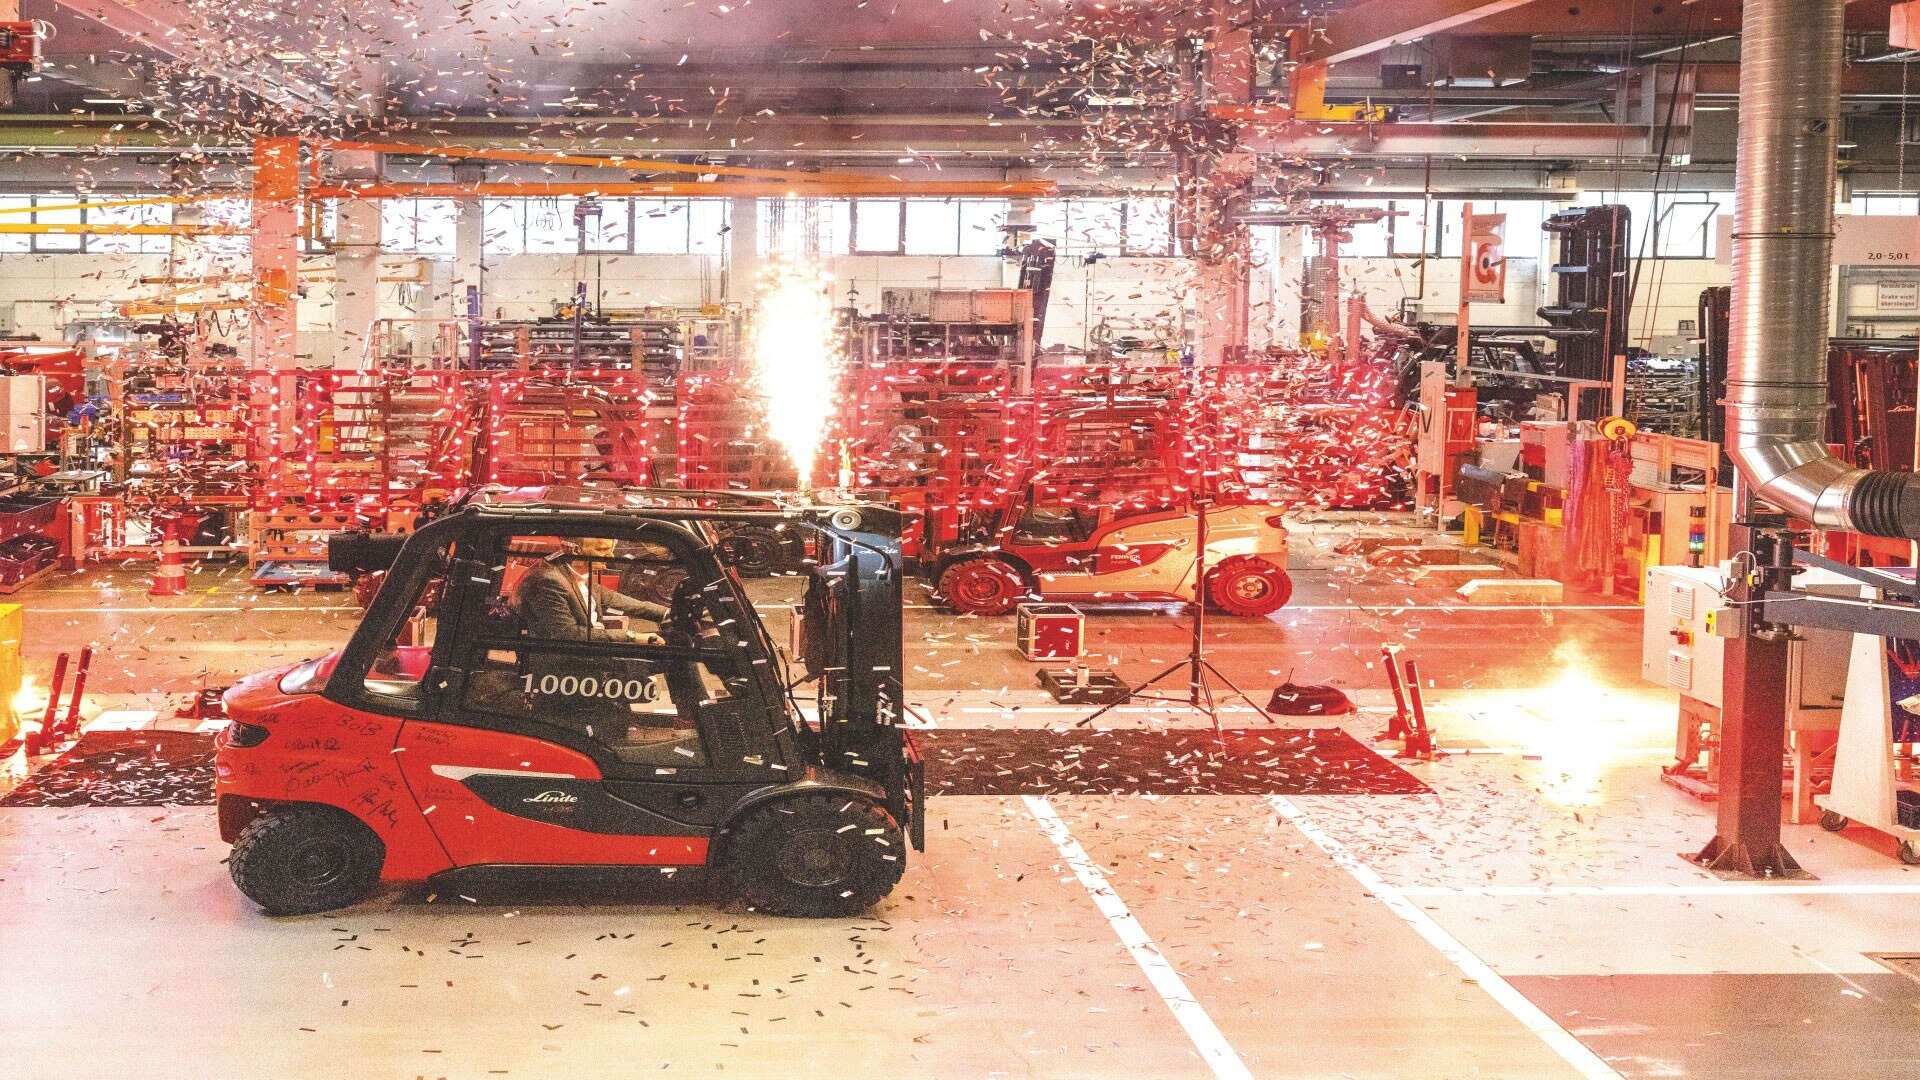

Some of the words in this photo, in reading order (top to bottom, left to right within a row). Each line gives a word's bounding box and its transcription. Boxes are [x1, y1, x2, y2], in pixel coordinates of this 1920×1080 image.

[1905, 252, 1910, 260] t
[520, 673, 661, 701] 1.000.000
[523, 790, 578, 803] Linde
